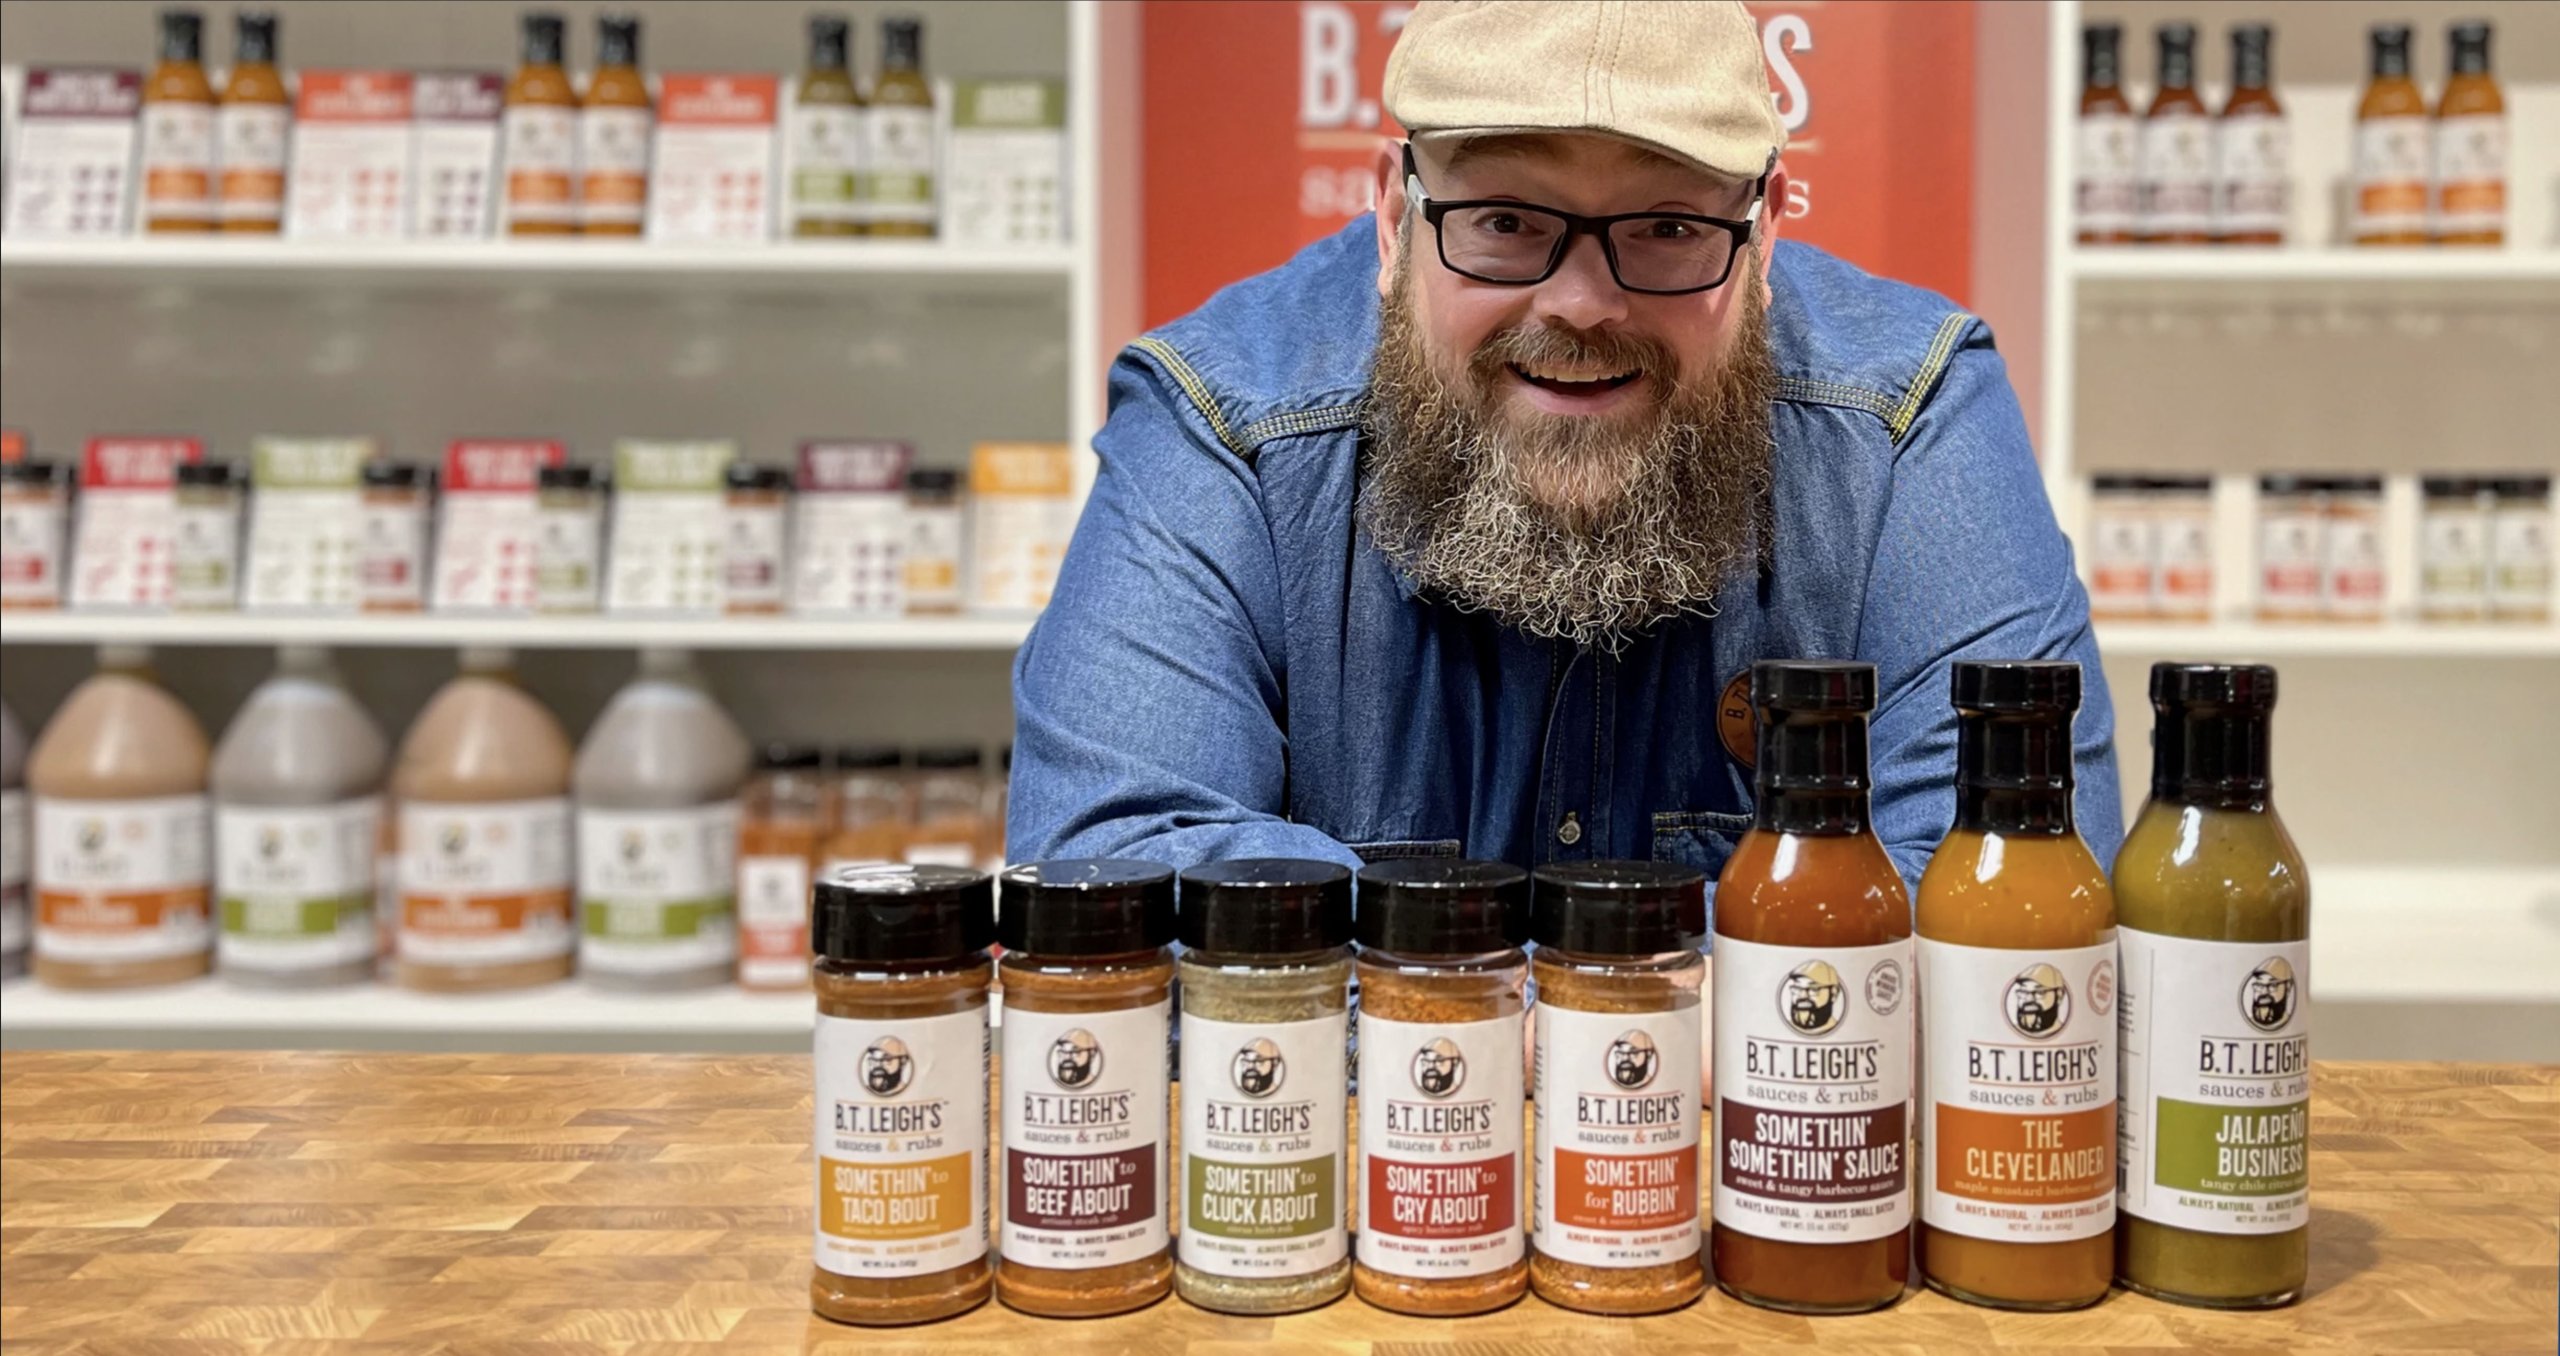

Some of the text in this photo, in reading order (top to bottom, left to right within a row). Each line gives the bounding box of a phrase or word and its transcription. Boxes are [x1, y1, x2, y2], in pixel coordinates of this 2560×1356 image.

[1747, 1041, 1785, 1079] B.T.
[1969, 1046, 2011, 1082] B.T.
[2200, 1040, 2244, 1074] B.T.
[1747, 1085, 1879, 1104] sauces & rubs
[1969, 1086, 2098, 1107] sauces & rubs
[2200, 1084, 2265, 1099] sauces
[2270, 1081, 2282, 1097] &
[836, 1103, 864, 1132] B.T.
[1024, 1095, 1054, 1124] B.T.
[1207, 1103, 1237, 1133] B.T.
[1387, 1103, 1418, 1133] B.T.
[1578, 1095, 1610, 1125] B.T.
[1024, 1127, 1130, 1145] sauces & rubs
[1578, 1127, 1681, 1145] sauces & rubs
[1755, 1112, 1872, 1147] SOMETHIN'
[2022, 1119, 2063, 1149] THE
[2216, 1107, 2305, 1144] JALAPEÑO
[836, 1135, 943, 1152] sauces & rubs
[1206, 1135, 1311, 1152] sauces & rubs
[1387, 1135, 1492, 1152] sauces & rubs
[1023, 1157, 1136, 1187] SOMETHIN' to
[1585, 1156, 1679, 1186] SOMETHIN'
[1729, 1138, 1899, 1181] SOMETHIN' SAUCE
[1966, 1146, 2104, 1182] CLEVELANDER
[2218, 1144, 2303, 1178] BUSINESS
[834, 1166, 949, 1195] SOMETHIN' to
[1205, 1166, 1316, 1196] SOMETHIN' to
[1386, 1165, 1497, 1196] SOMETHIN' to
[1735, 1175, 1763, 1190] sweet
[1765, 1179, 1776, 1192] &
[1779, 1182, 1814, 1197] tangy
[1816, 1183, 1868, 1196] barbecue
[1954, 1180, 1988, 1193] maple
[1992, 1185, 2042, 1197] mustard
[2201, 1178, 2236, 1191] tangy
[2239, 1180, 2265, 1191] chile
[842, 1195, 940, 1225] TACO BOUT
[1026, 1184, 1132, 1216] BEEF ABOUT
[1202, 1192, 1318, 1225] CLUCK ABOUT
[1392, 1195, 1490, 1225] CRY ABOUT
[1585, 1192, 1610, 1209] for
[1612, 1185, 1679, 1216] RUBBIN'
[1735, 1197, 1895, 1218] ALWAYS NATURAL ALWAYS SMALL BATCH
[1955, 1203, 1986, 1216] ALWAYS
[1990, 1209, 2028, 1220] NATURAL
[2041, 1208, 2073, 1220] ALWAYS
[2179, 1196, 2214, 1210] ALWAYS
[2216, 1202, 2254, 1212] NATURAL
